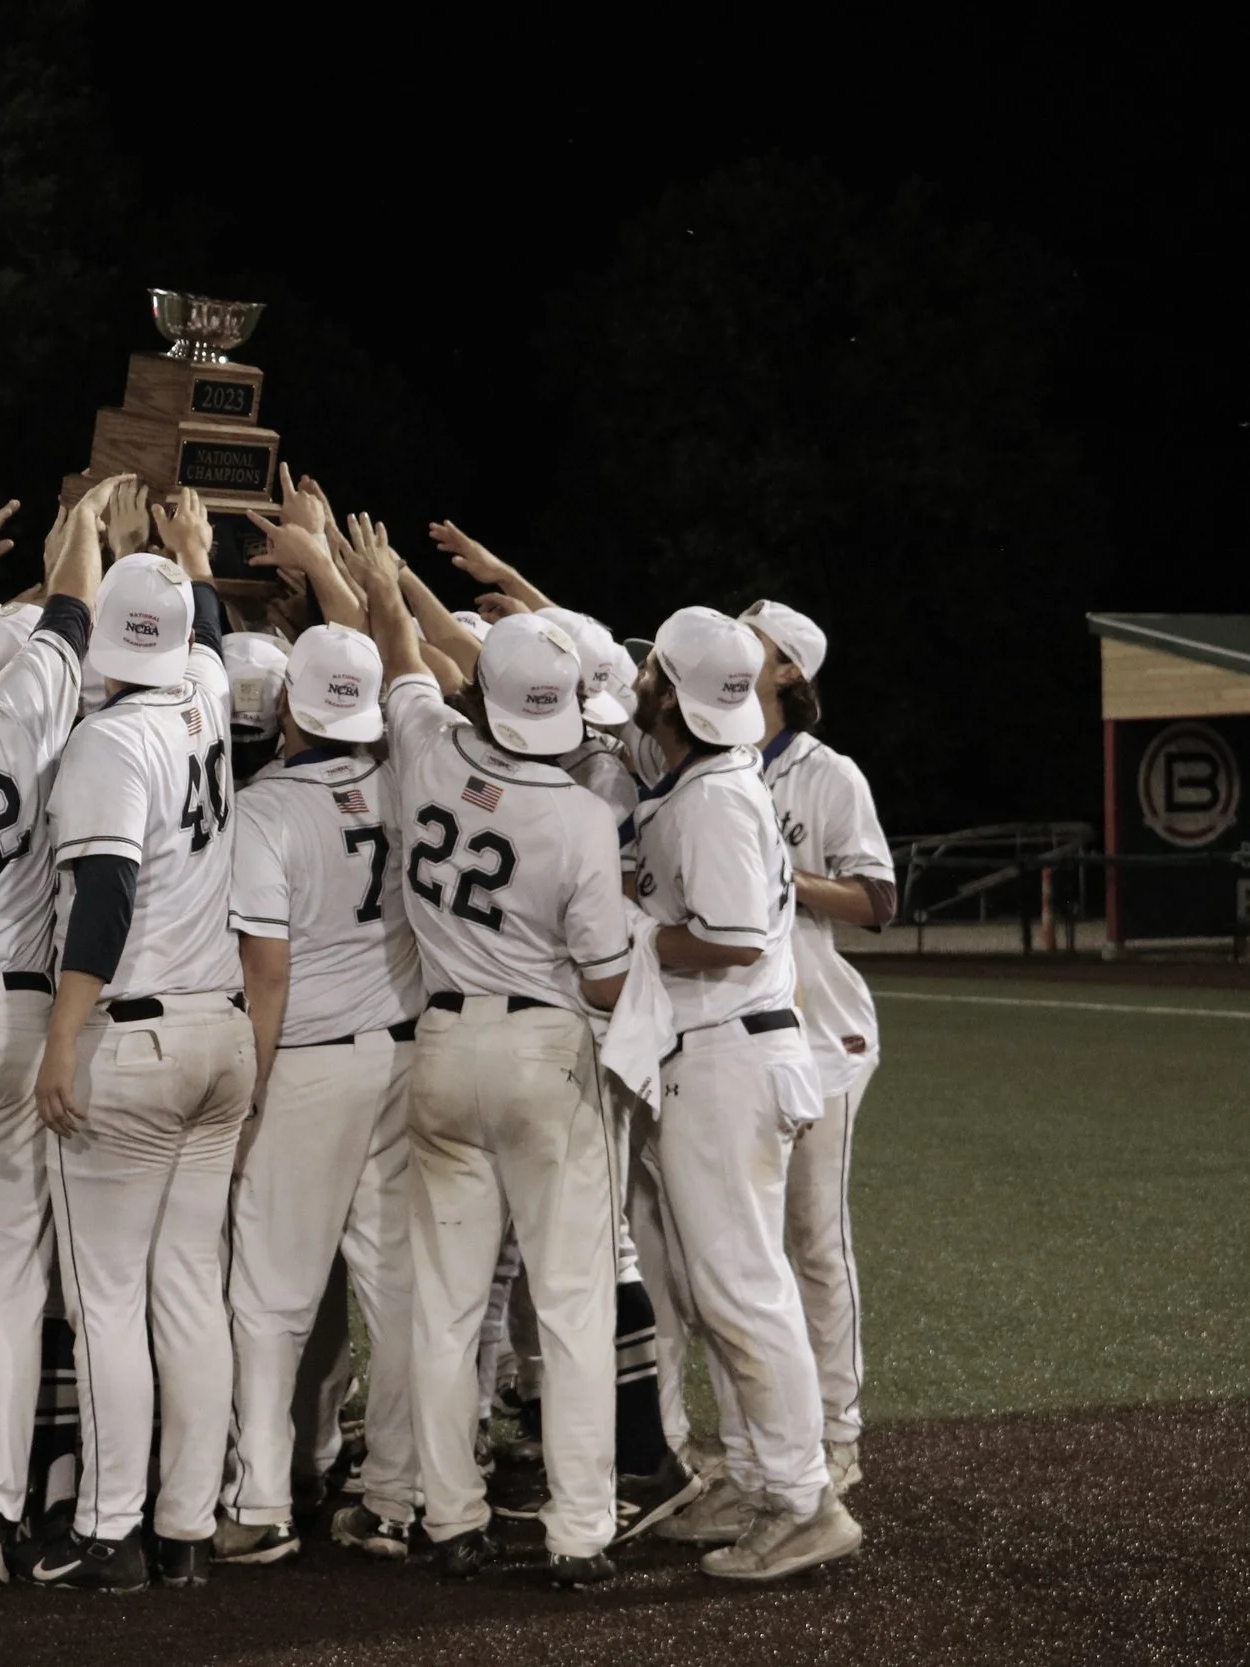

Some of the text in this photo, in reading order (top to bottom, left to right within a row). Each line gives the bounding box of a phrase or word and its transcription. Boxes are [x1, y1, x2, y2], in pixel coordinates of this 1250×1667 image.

[201, 385, 245, 411] 2023
[197, 449, 254, 468] NATIONAL
[186, 464, 261, 485] CHAMPIONS
[125, 620, 160, 638] NCBA
[327, 683, 360, 699] NCBA
[1162, 751, 1220, 814] B
[341, 823, 392, 927] 7
[406, 800, 519, 933] 22
